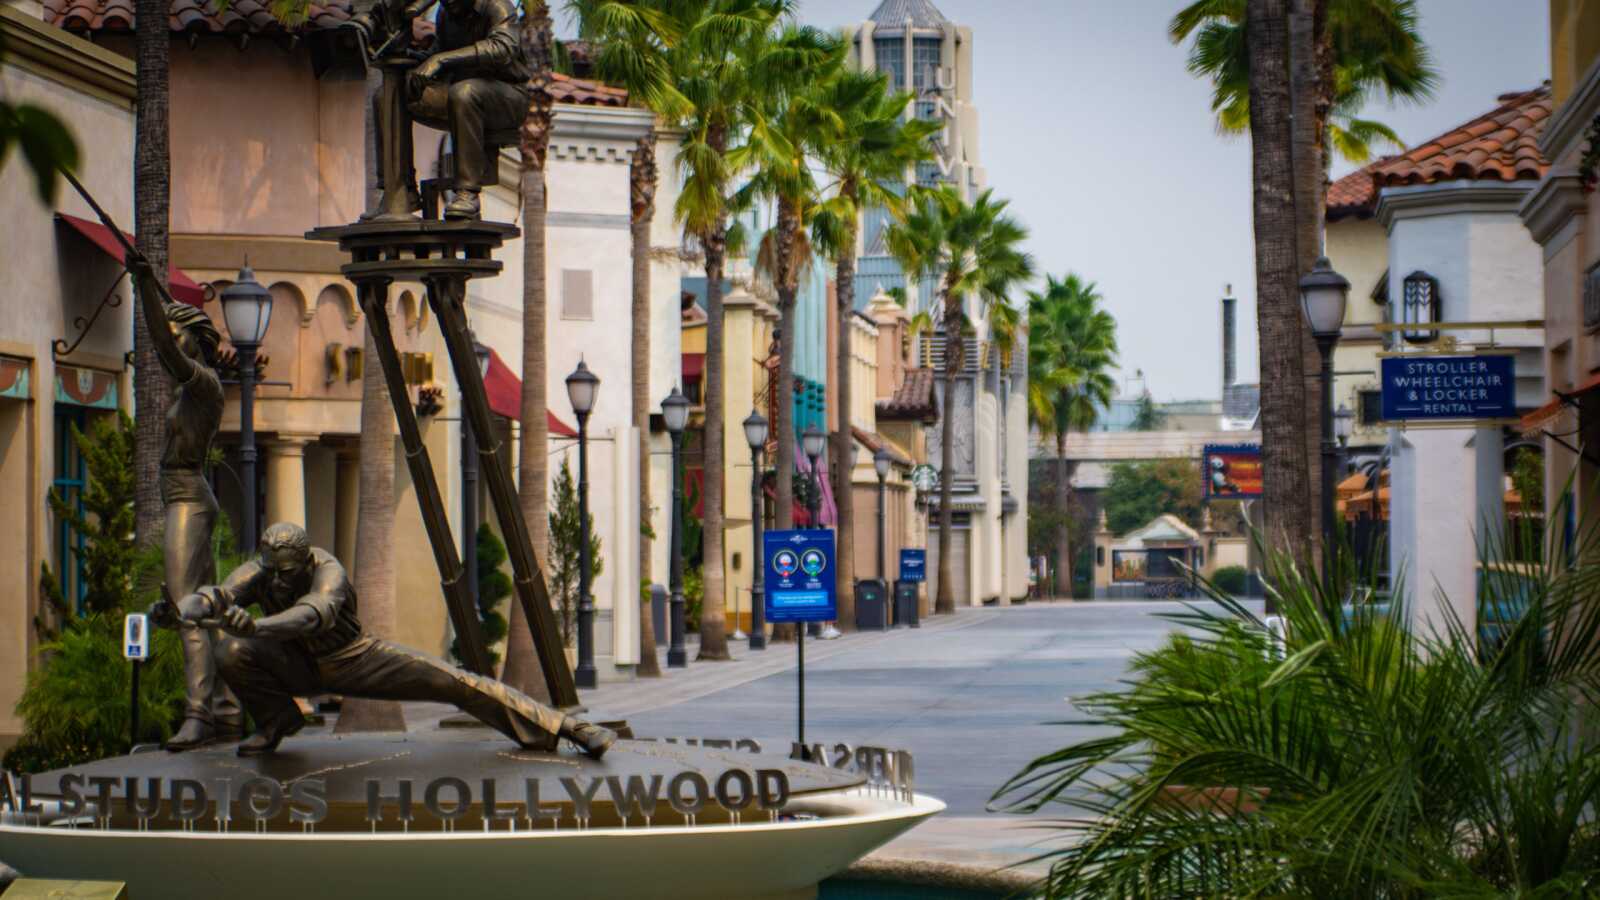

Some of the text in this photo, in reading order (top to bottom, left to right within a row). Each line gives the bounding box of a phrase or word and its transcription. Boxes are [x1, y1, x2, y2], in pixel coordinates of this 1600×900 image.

[1407, 362, 1488, 374] STROLLER
[1395, 375, 1502, 387] WHEELCHAIR
[1409, 389, 1488, 401] & LOCKER
[1424, 403, 1474, 414] RENTAL
[58, 773, 328, 823] STUDIOS
[365, 767, 790, 821] HOLLYWOOD
